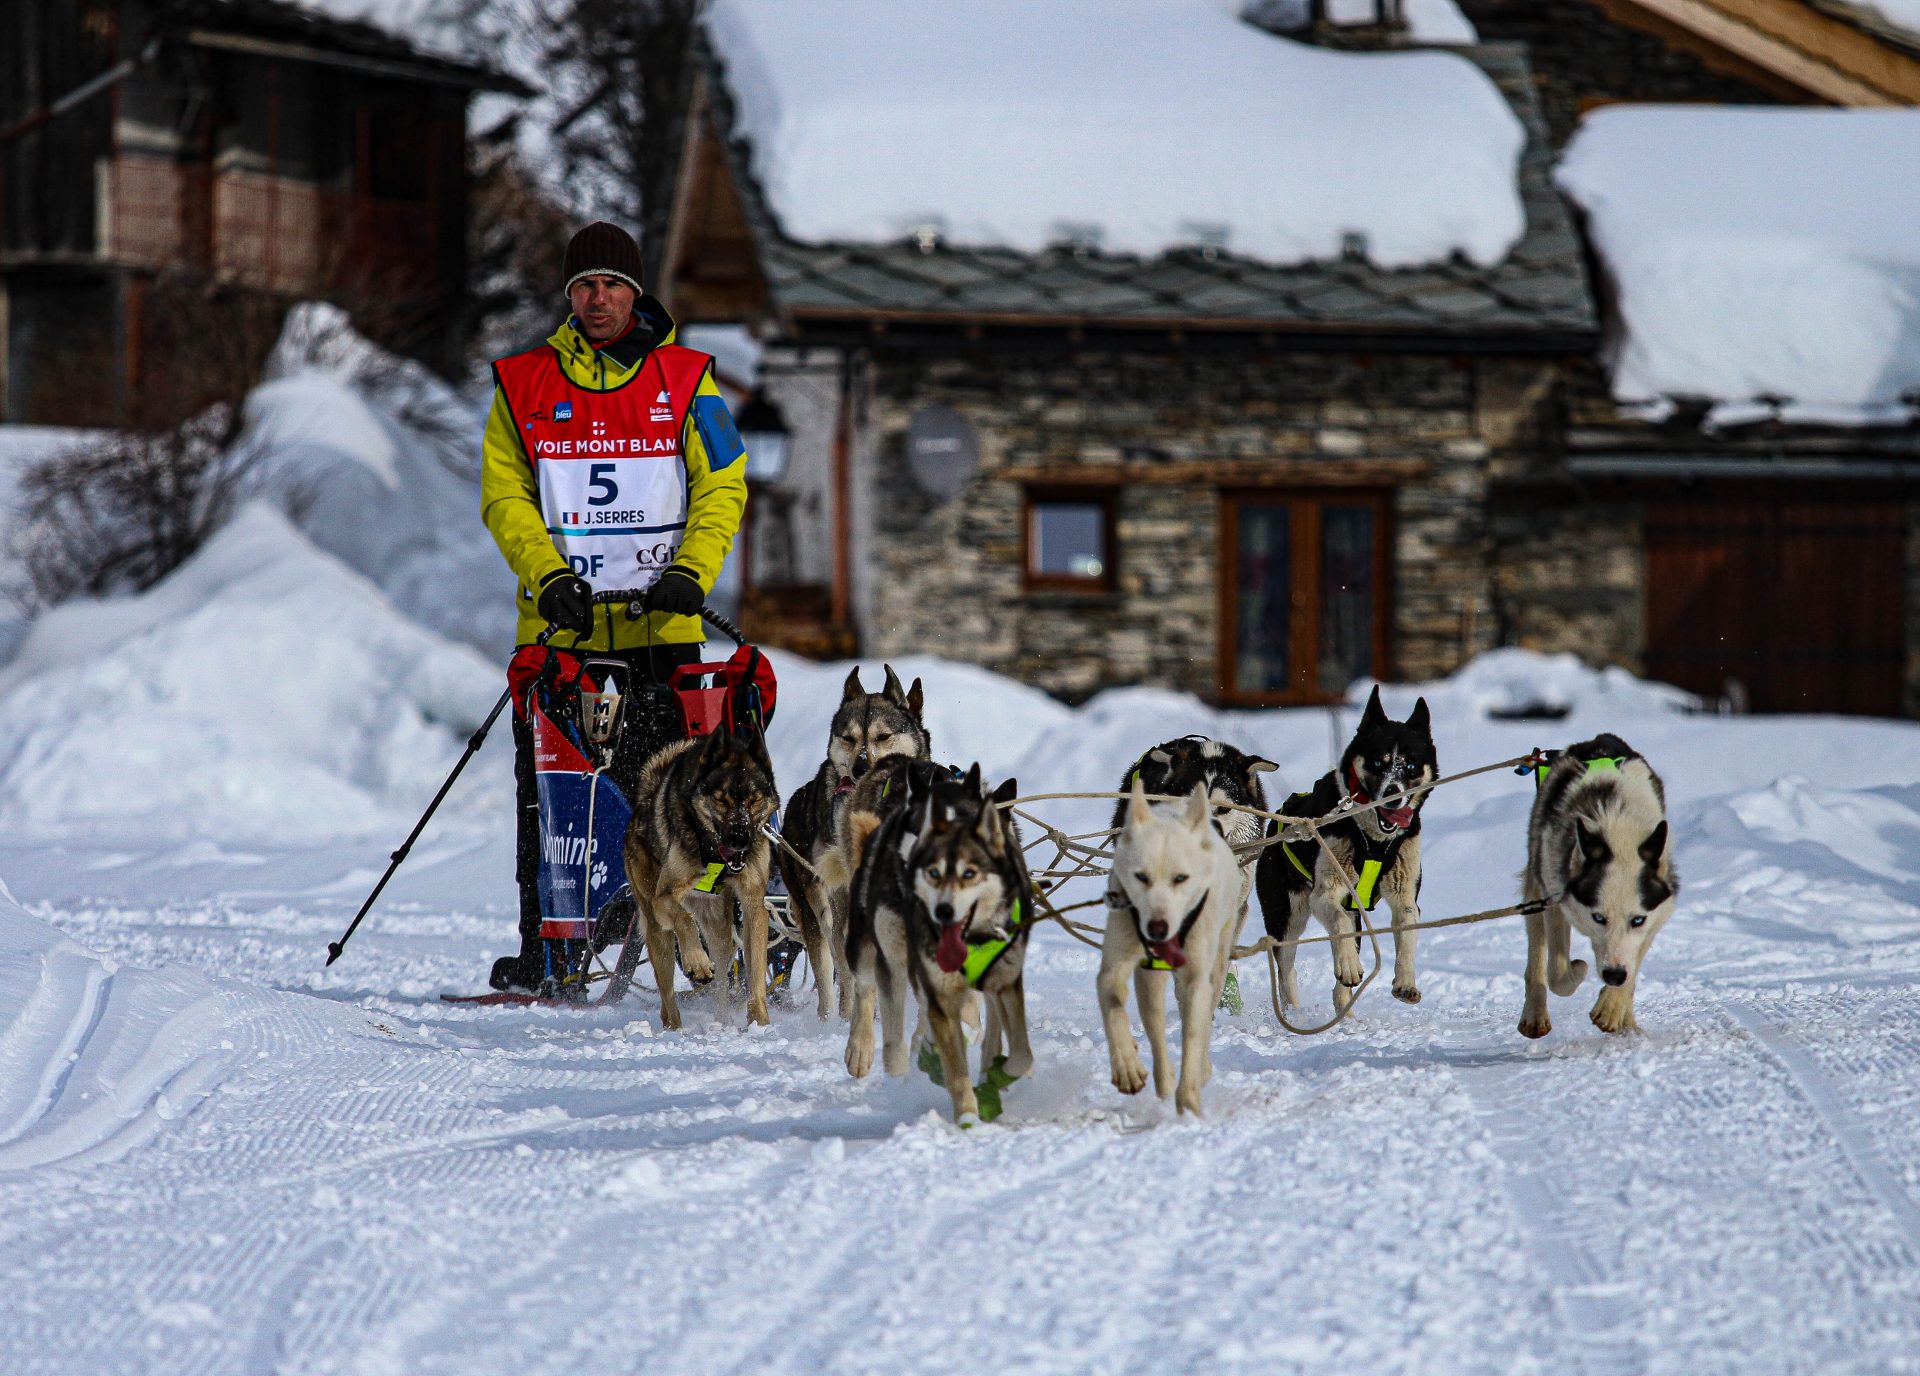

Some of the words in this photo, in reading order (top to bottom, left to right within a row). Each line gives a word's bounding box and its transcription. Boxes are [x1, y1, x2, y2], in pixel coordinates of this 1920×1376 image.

[576, 440, 627, 454] MONT
[587, 463, 619, 507] 5
[584, 510, 645, 525] J.SERRES
[569, 554, 604, 578] DF
